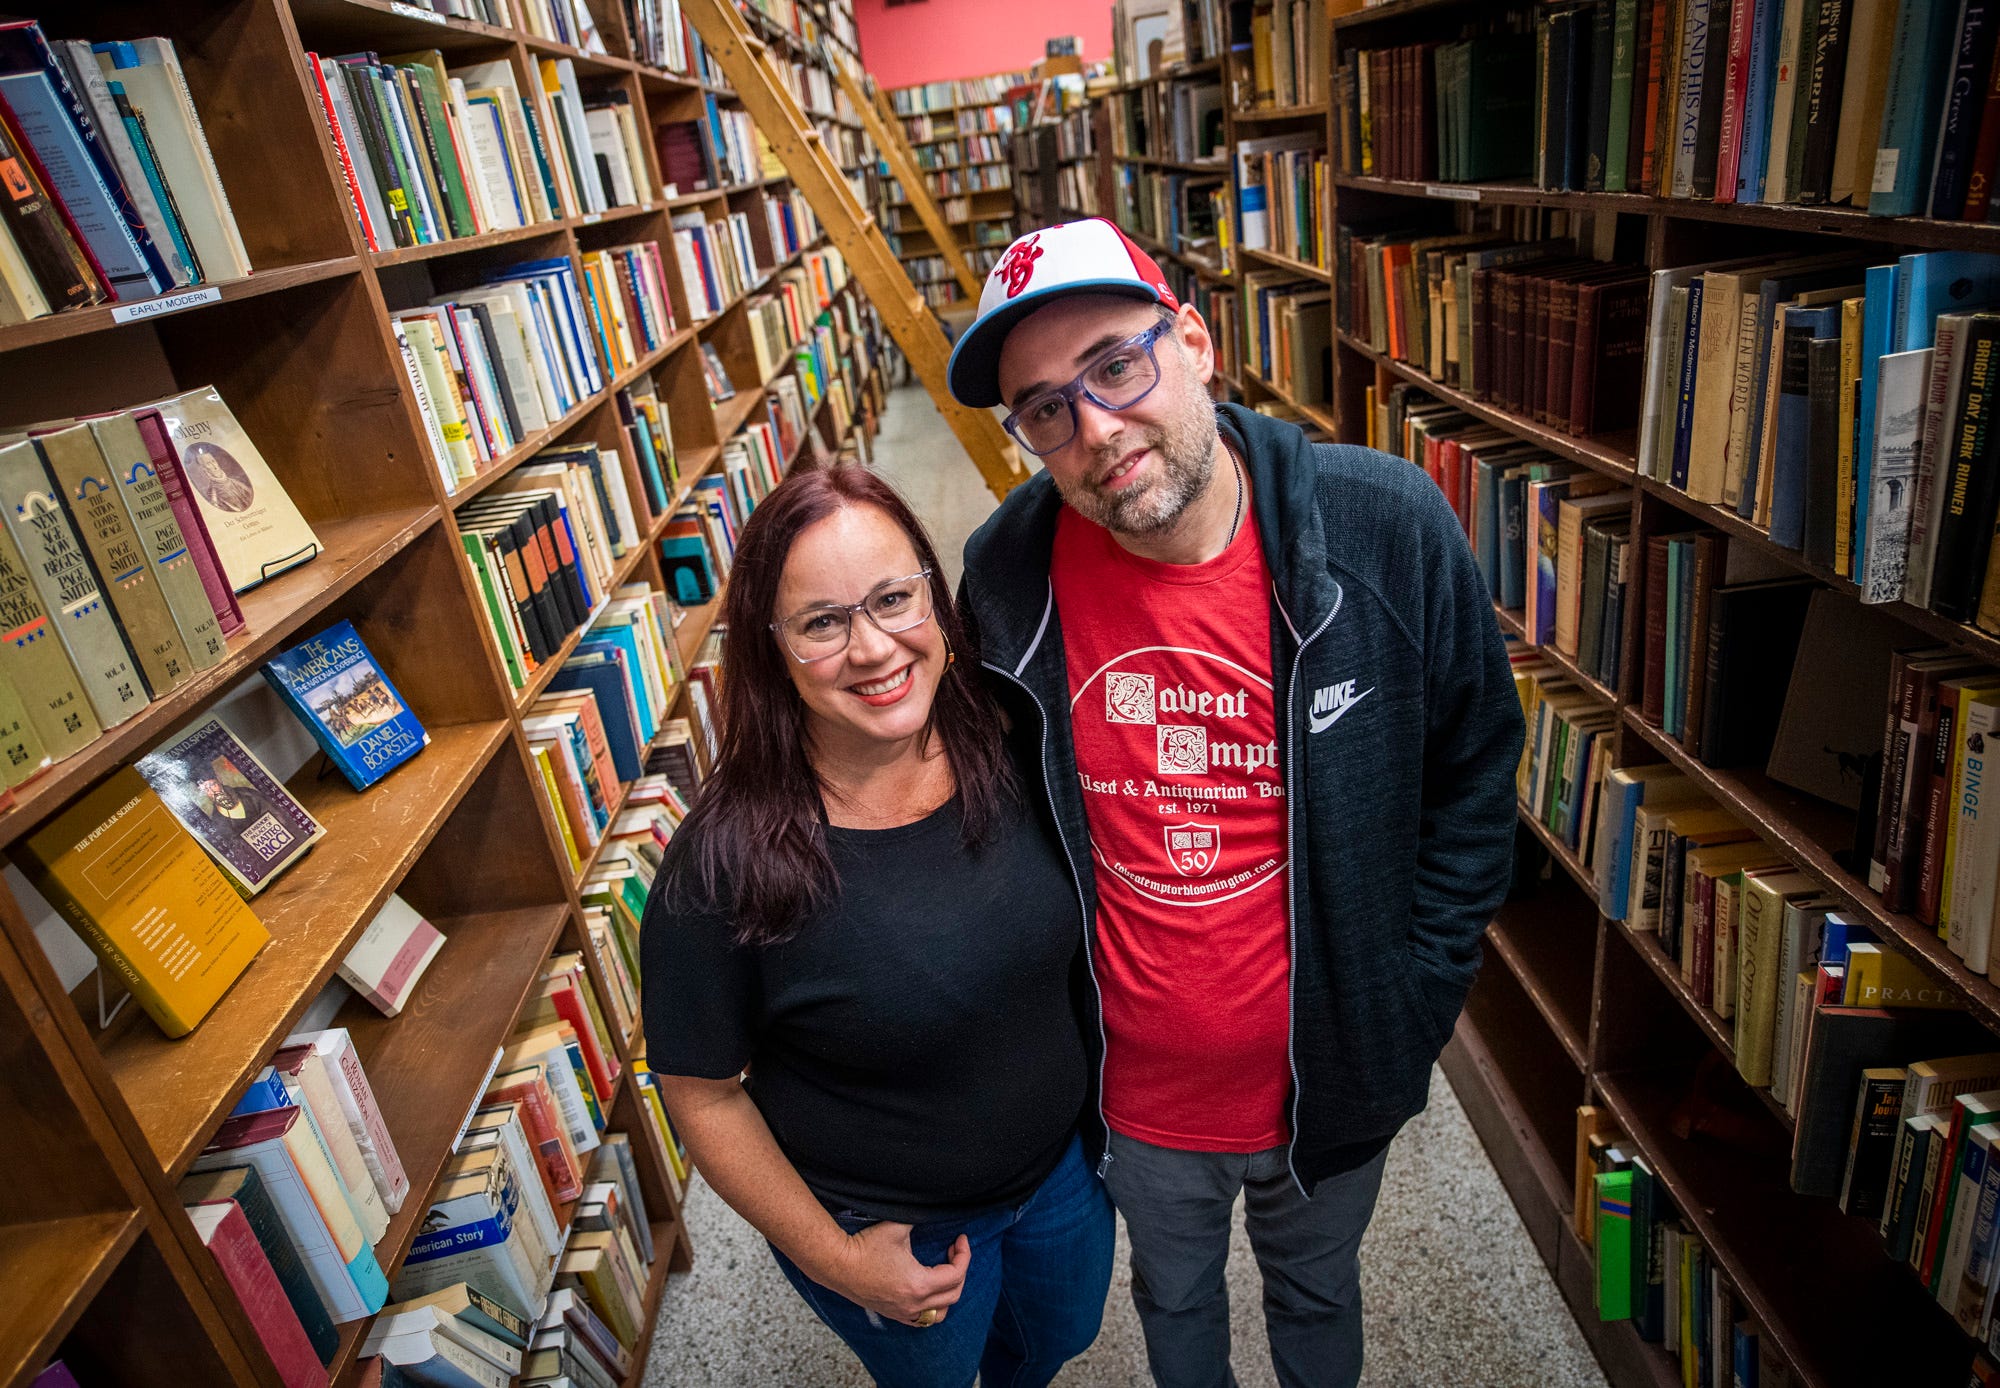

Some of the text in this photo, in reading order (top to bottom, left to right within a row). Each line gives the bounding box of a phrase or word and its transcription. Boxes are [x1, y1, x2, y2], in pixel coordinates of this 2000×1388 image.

[1755, 0, 1764, 19] THE
[1689, 19, 1708, 69] AND
[1960, 4, 1984, 56] How
[1678, 57, 1689, 104] KIRK
[1719, 0, 1744, 154] HOUSE OF HARPER
[1746, 53, 1759, 108] BOOKMAN'S
[1806, 32, 1827, 125] WARREN
[1958, 61, 1974, 71] I
[1684, 72, 1703, 110] HIS
[1946, 75, 1972, 136] Grew
[329, 113, 349, 160] THOMAS
[1680, 111, 1700, 156] AGE
[1742, 109, 1753, 155] YEARBOOK
[120, 222, 143, 258] BRITAIN
[129, 292, 208, 317] EARLY MODERN
[1689, 286, 1701, 324] Preface
[1688, 326, 1696, 337] to
[1739, 301, 1757, 355] STOLEN
[1935, 327, 1954, 357] LOUIS
[1683, 338, 1696, 390] Modernism
[1844, 342, 1852, 356] The
[403, 353, 431, 412] CAPITAL CITY
[1733, 361, 1750, 413] WORDS
[1929, 359, 1950, 405] L'AMOUR
[1922, 409, 1943, 455] Education
[1950, 337, 1992, 515] BRIGHT DAY, DARK RUNNER
[1840, 454, 1848, 474] Philip
[87, 502, 116, 520] NATION
[88, 494, 105, 508] THE
[140, 490, 165, 507] ENTERS
[1912, 473, 1933, 524] Wandering
[30, 508, 58, 532] NEW
[93, 513, 120, 531] COMES
[136, 509, 154, 523] THE
[41, 524, 65, 546] AGE
[154, 523, 178, 543] PAGE
[156, 534, 185, 556] SMITH
[1911, 524, 1927, 545] Man
[42, 549, 83, 577] BEGINS
[43, 541, 71, 558] NOW
[107, 540, 133, 562] PAGE
[110, 554, 140, 575] SMITH
[57, 568, 89, 590] PAGE
[59, 584, 97, 606] SMITH
[0, 608, 42, 633] SMITH
[1, 594, 28, 615] PAGE
[286, 638, 359, 688] AMERICANS:
[300, 639, 328, 660] THE
[307, 669, 337, 687] NATIONAL
[335, 650, 367, 671] EXPERIENCE
[1314, 679, 1356, 714] NIKE
[1901, 683, 1915, 718] PALMER
[189, 720, 220, 742] SPENCE
[359, 725, 397, 755] DANIEL
[1897, 734, 1909, 756] THE
[363, 730, 415, 771] BOORSTIN
[1079, 771, 1117, 796] Used
[1122, 780, 1139, 796] &
[1143, 779, 1247, 800] Antiquarian
[1893, 756, 1906, 797] COURAGE
[1961, 757, 1983, 820] BINGE
[88, 816, 121, 846] POPULAR
[117, 796, 142, 819] SCHOOL
[1158, 802, 1217, 815] est. 1971
[252, 824, 282, 850] MATTEO
[1888, 815, 1899, 842] TEACH
[1919, 787, 1941, 892] Learning from the Past
[259, 834, 292, 861] RICCI
[1181, 850, 1208, 870] 50
[1114, 858, 1277, 896] caveatemptorbloomington.com
[1745, 890, 1763, 939] OUT
[79, 917, 114, 954] POPULAR
[112, 952, 142, 985] SCHOOL
[1741, 958, 1756, 1013] STEP
[342, 1057, 368, 1120] CIVILIZATION
[351, 1061, 369, 1098] ROMAN
[1978, 1184, 1998, 1220] SILVER
[454, 1226, 485, 1246] Story
[1974, 1216, 1992, 1242] STAR
